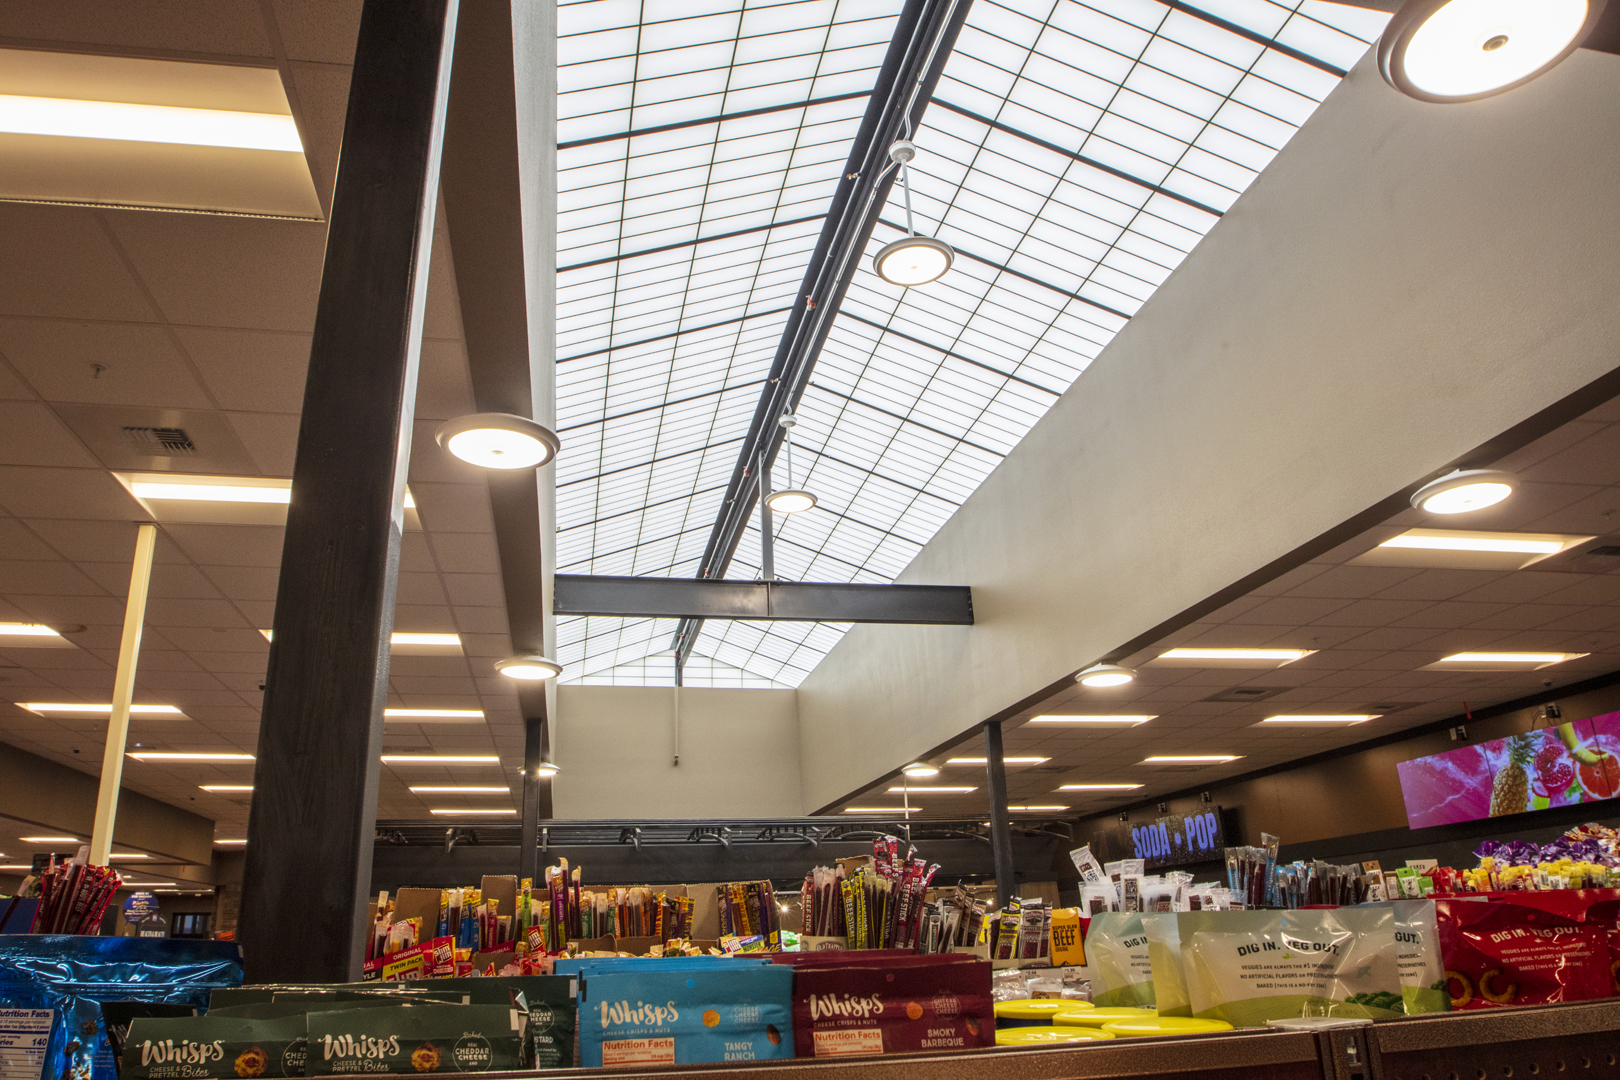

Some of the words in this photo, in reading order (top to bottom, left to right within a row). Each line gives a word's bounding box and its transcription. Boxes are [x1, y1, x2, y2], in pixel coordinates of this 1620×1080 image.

[1132, 823, 1171, 859] SODA
[1184, 813, 1217, 851] POP
[846, 898, 854, 916] BEEF
[899, 902, 908, 922] STICK
[847, 916, 856, 936] STICK
[1053, 929, 1075, 946] BEEF
[1395, 932, 1419, 944] OUT.
[1490, 930, 1512, 943] DIG
[1512, 928, 1529, 938] IN.
[1530, 927, 1552, 938] VEG
[1554, 926, 1583, 935] OUT.
[1124, 938, 1140, 948] DIG
[1237, 943, 1260, 957] DIG
[1263, 941, 1280, 950] IN.
[1286, 942, 1309, 950] VEG
[1313, 943, 1339, 956] OUT.
[393, 948, 422, 960] ORIGINAL
[390, 960, 406, 971] TWIN
[407, 957, 423, 966] PACK
[804, 993, 884, 1020] Whisps
[594, 1000, 679, 1028] Whisps
[815, 1032, 856, 1040] Nutrition
[928, 1028, 956, 1037] SMOKY
[318, 1034, 400, 1060] Whisps
[604, 1040, 645, 1050] Nutrition
[724, 1042, 753, 1051] TANGY
[921, 1037, 964, 1048] BARBEQUE
[135, 1039, 225, 1067] Whisps
[724, 1052, 755, 1061] RANCH
[181, 1064, 209, 1078] Bites
[364, 1060, 390, 1072] Bites
